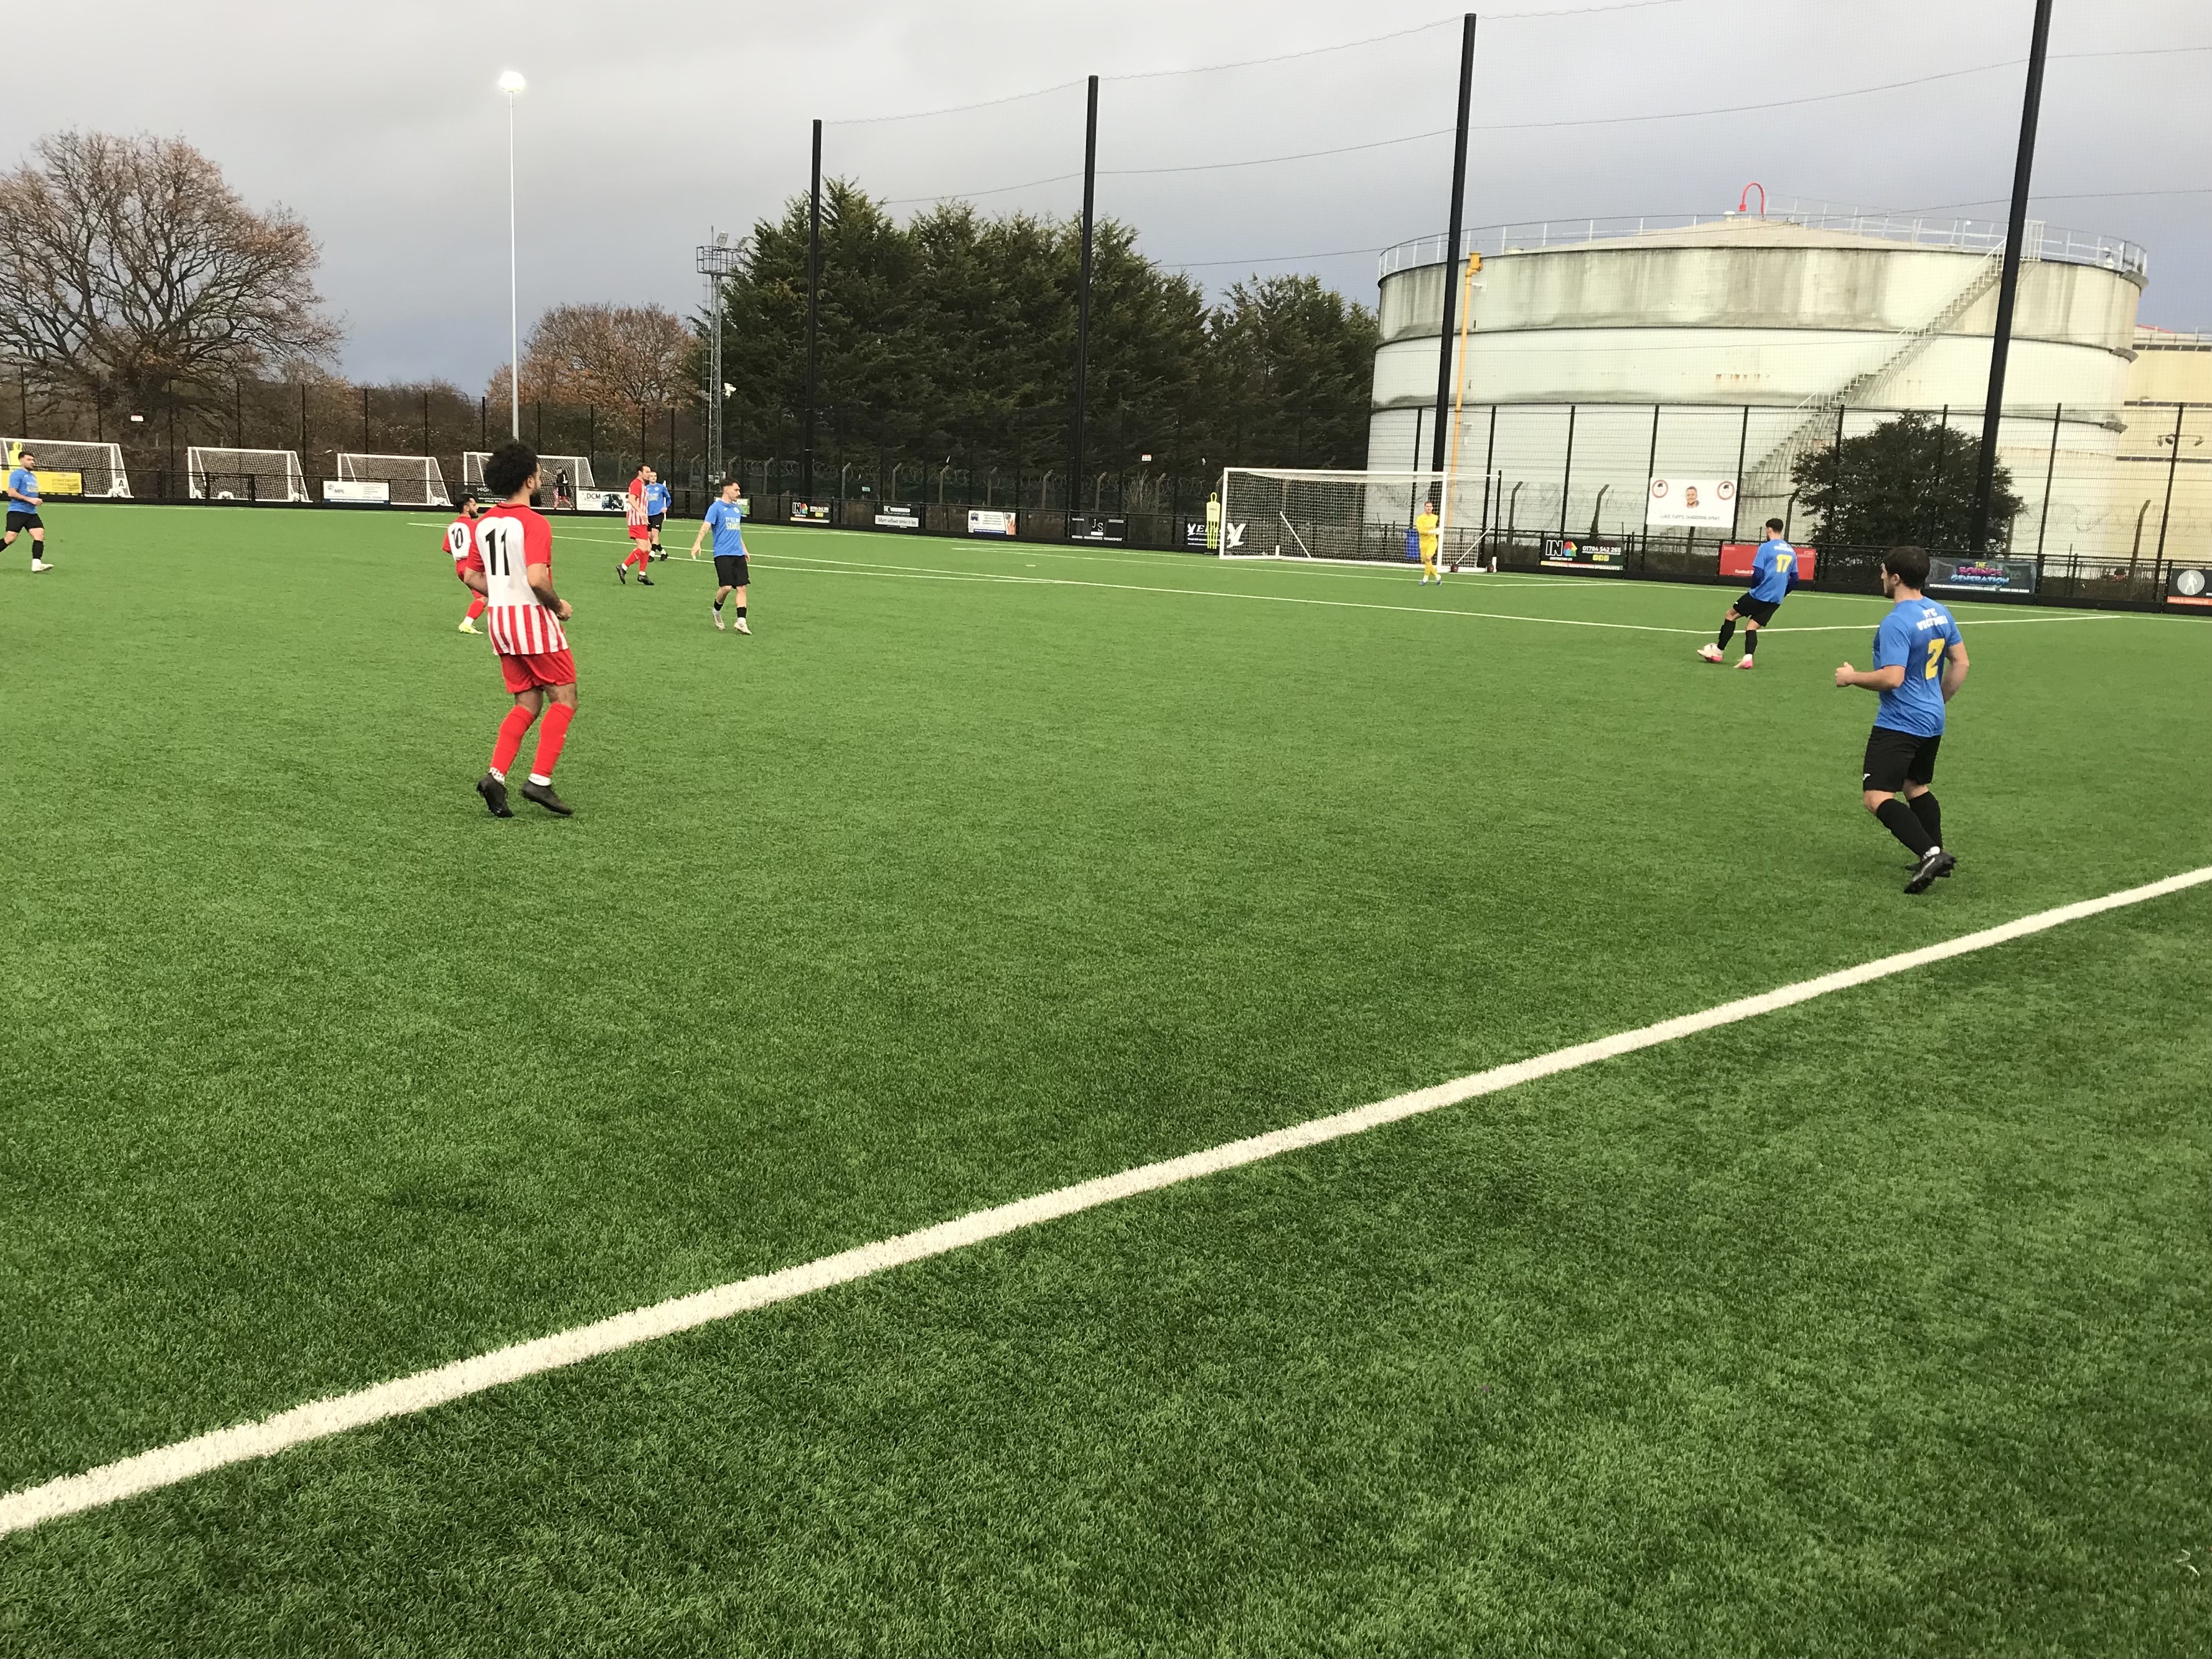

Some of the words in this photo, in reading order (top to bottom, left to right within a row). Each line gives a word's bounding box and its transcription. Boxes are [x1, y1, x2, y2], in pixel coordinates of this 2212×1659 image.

[451, 527, 464, 549] 10
[485, 528, 510, 576] 11
[1545, 540, 1563, 557] IN
[1776, 554, 1793, 573] 17
[1959, 566, 2003, 576] BOUNCE
[1950, 575, 2010, 585] GENERATION
[1925, 638, 1945, 680] 2
